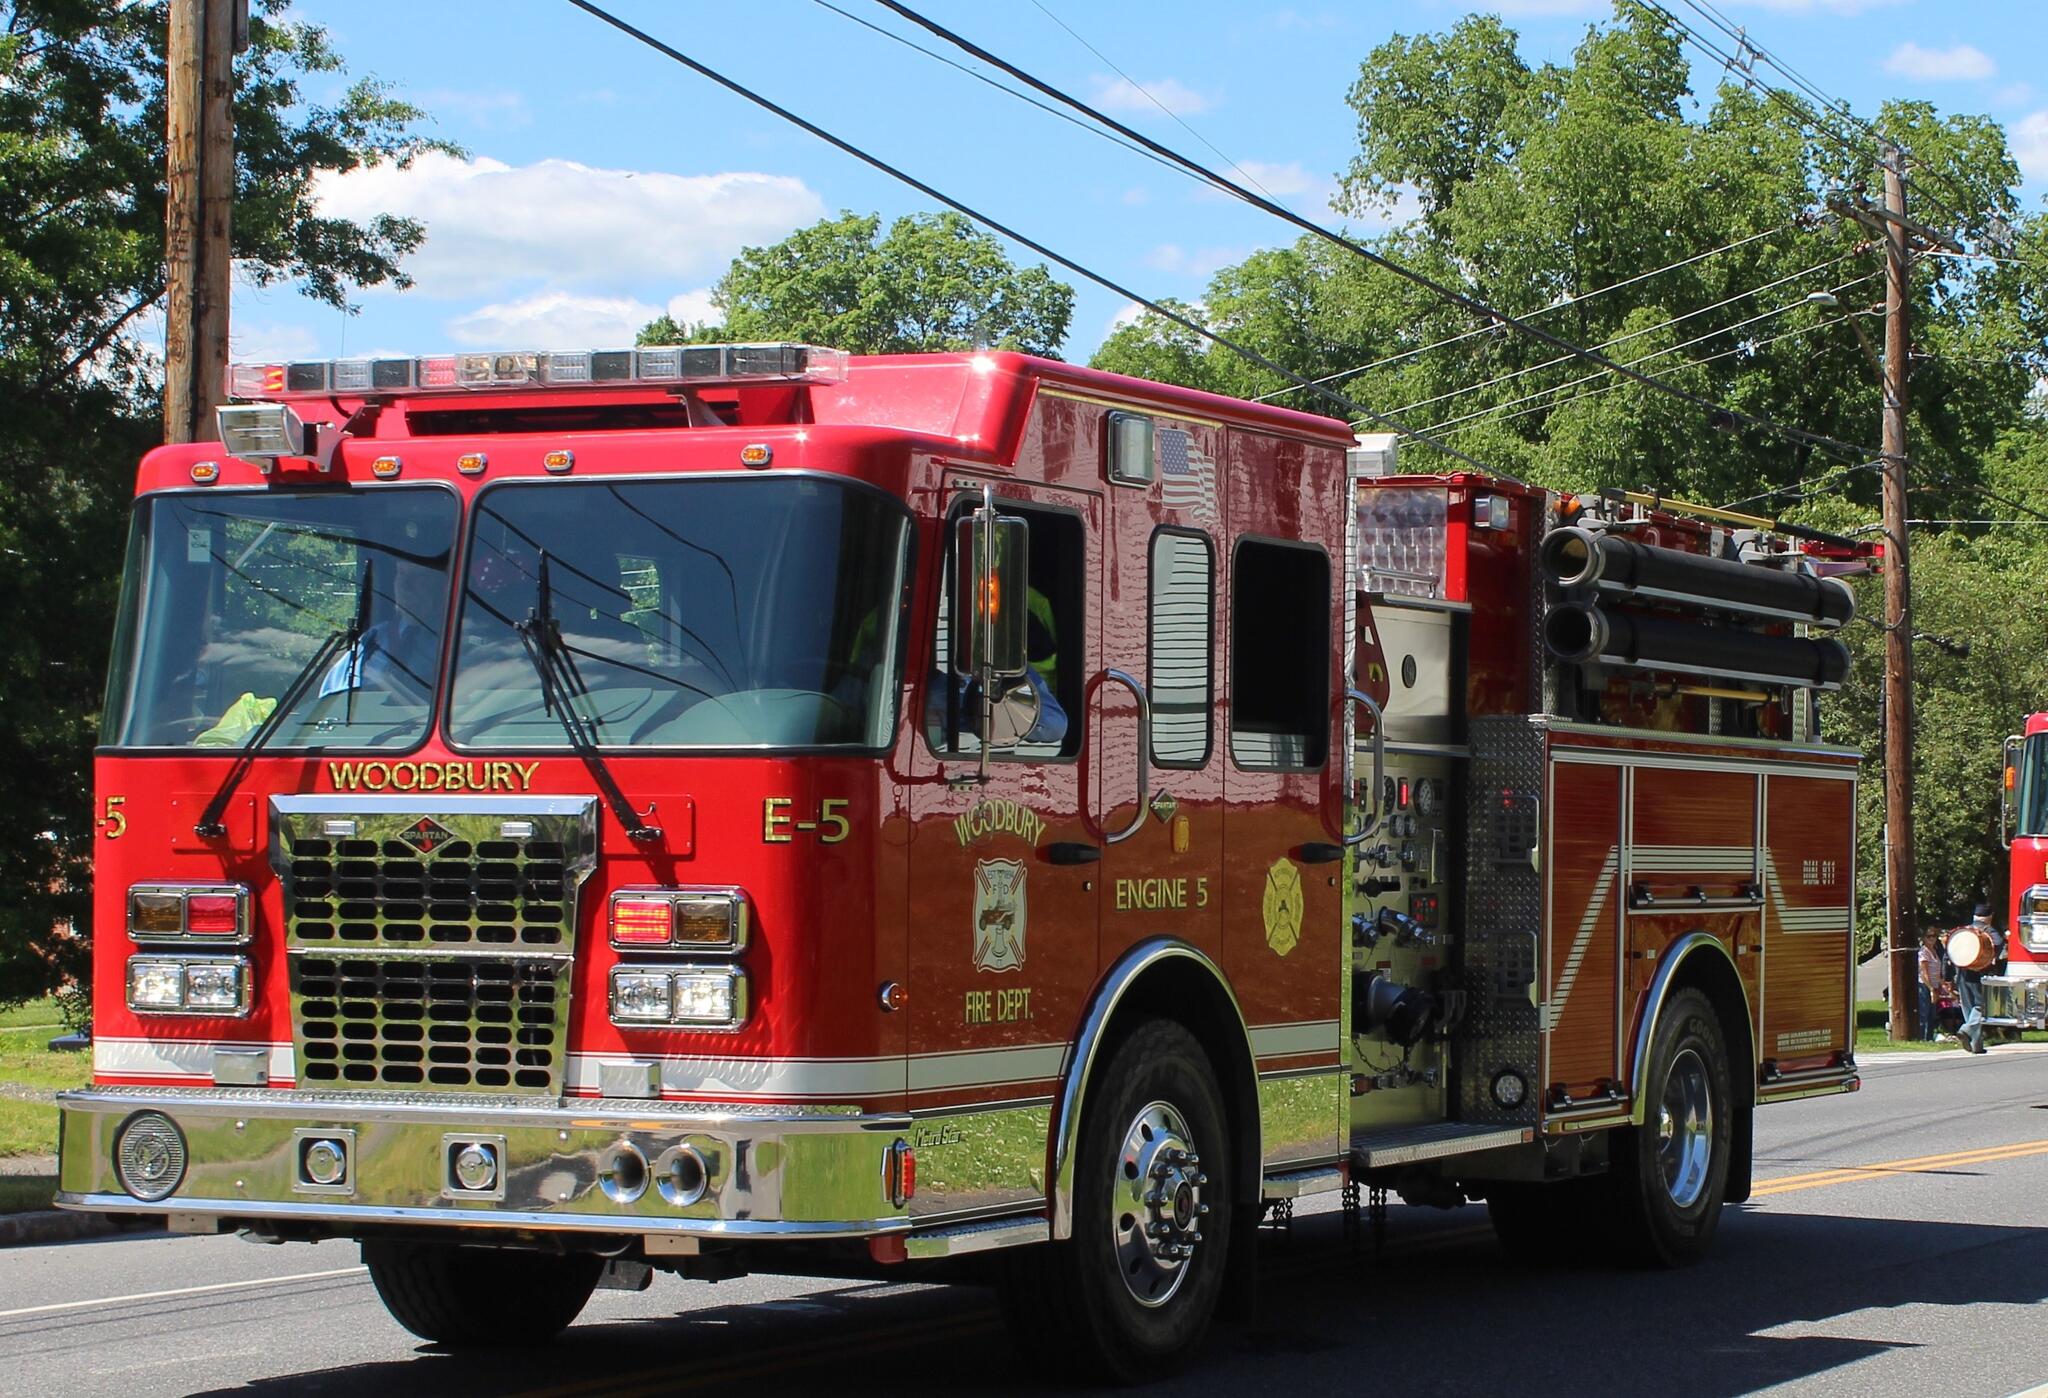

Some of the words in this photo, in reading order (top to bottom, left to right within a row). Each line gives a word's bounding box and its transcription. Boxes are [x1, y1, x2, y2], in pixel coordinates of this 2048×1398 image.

[329, 762, 540, 791] WOODBURY
[403, 831, 448, 840] SPARTAN
[764, 798, 850, 842] E-5
[954, 799, 1046, 847] WOODBURY
[1116, 878, 1187, 909] ENGINE
[1196, 877, 1208, 907] 5
[965, 990, 992, 1023] FIRE
[997, 987, 1034, 1021] DEPT.
